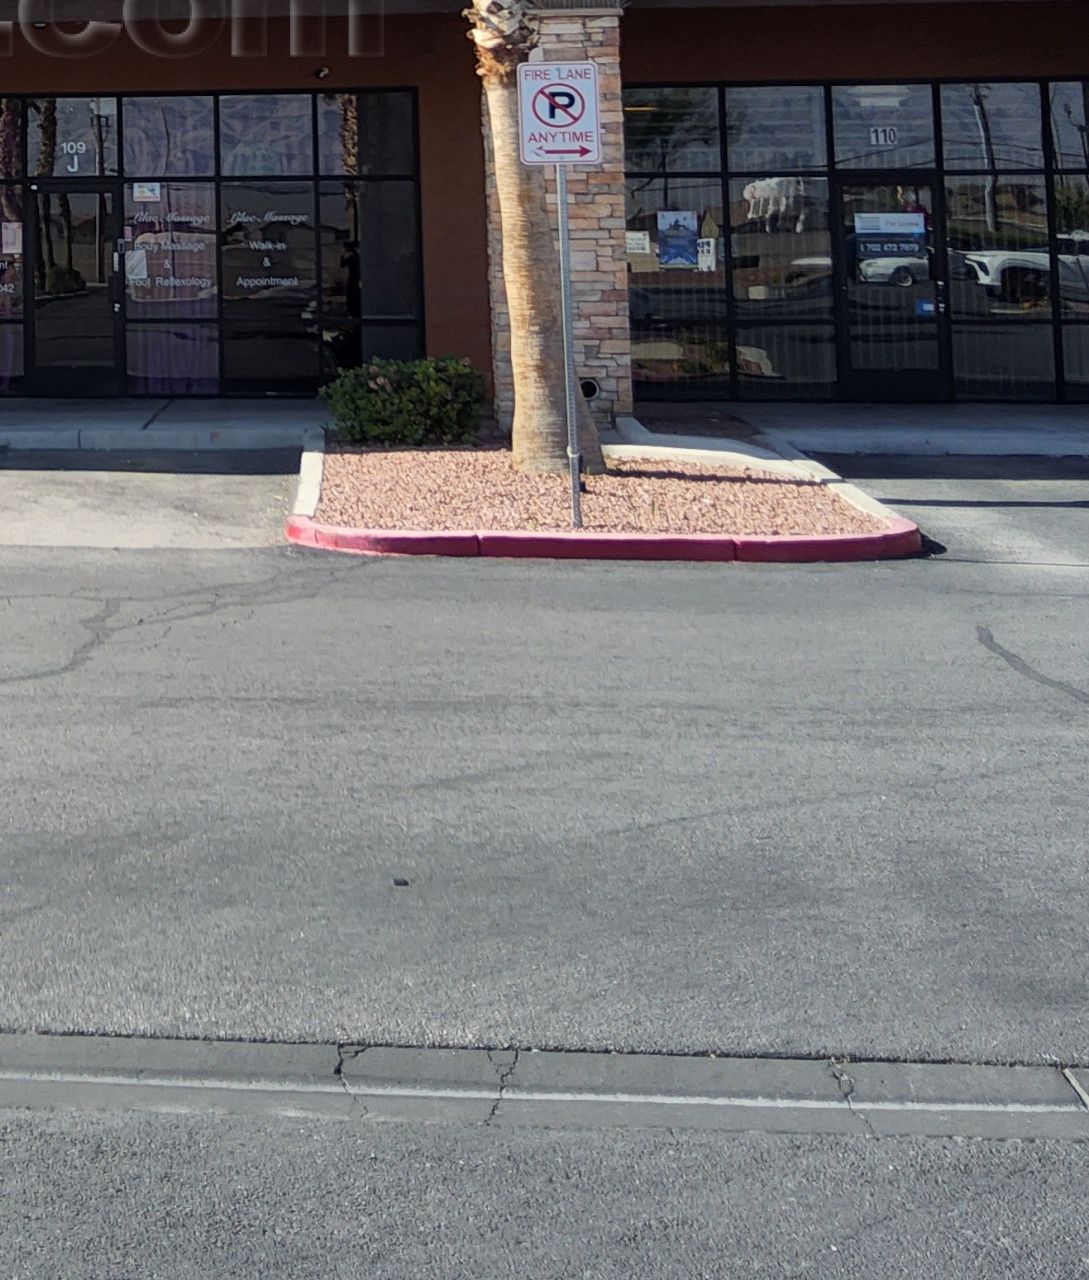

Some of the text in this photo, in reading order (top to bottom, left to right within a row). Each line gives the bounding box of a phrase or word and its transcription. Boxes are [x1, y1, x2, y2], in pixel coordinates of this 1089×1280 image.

[524, 68, 592, 80] FIRE LANE
[527, 131, 594, 143] ANYTIME
[872, 128, 896, 143] 110
[61, 141, 86, 154] 109
[67, 155, 78, 172] J
[249, 239, 288, 251] Walk-in
[262, 257, 272, 267] &
[235, 276, 299, 288] Appointment
